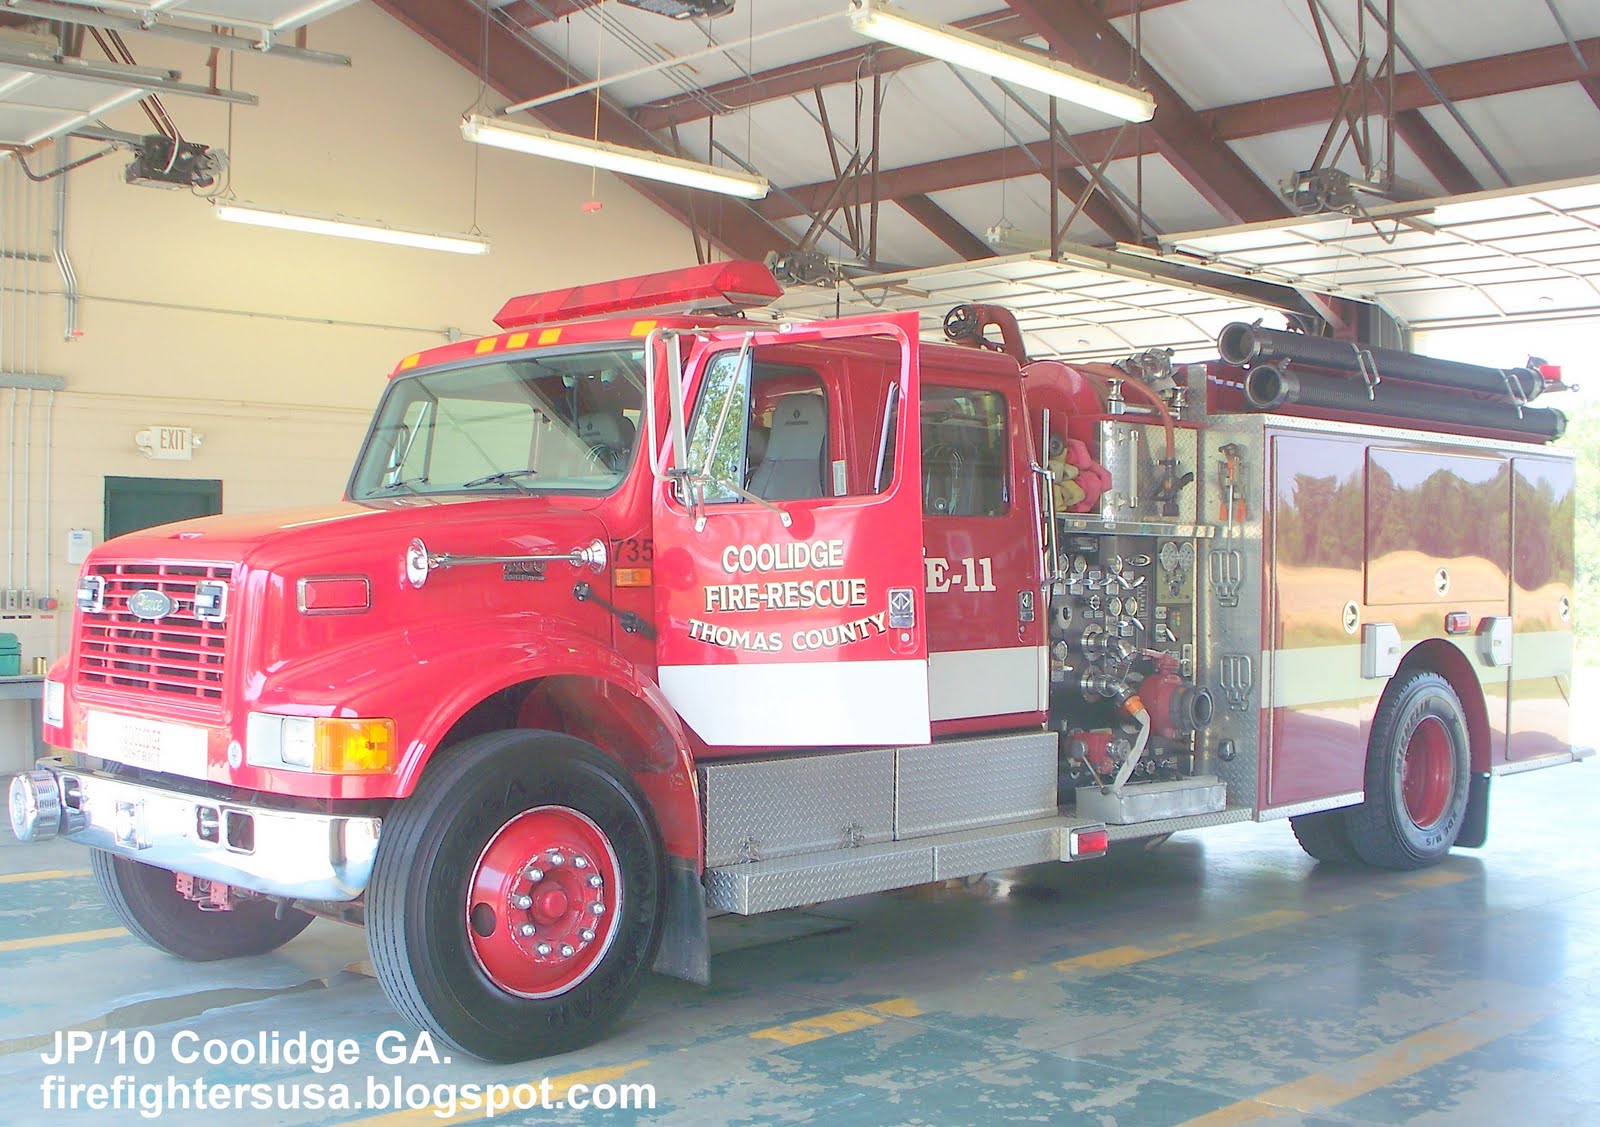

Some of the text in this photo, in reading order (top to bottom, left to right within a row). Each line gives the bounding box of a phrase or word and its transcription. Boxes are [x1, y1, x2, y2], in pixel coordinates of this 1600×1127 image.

[160, 428, 186, 450] EXIT
[721, 539, 844, 574] COOLIDGE
[924, 557, 996, 593] E-11
[704, 578, 867, 613] FIRE-RESCUE
[688, 610, 887, 652] THOMAS COUNTY
[1395, 698, 1432, 777] MICHELIN
